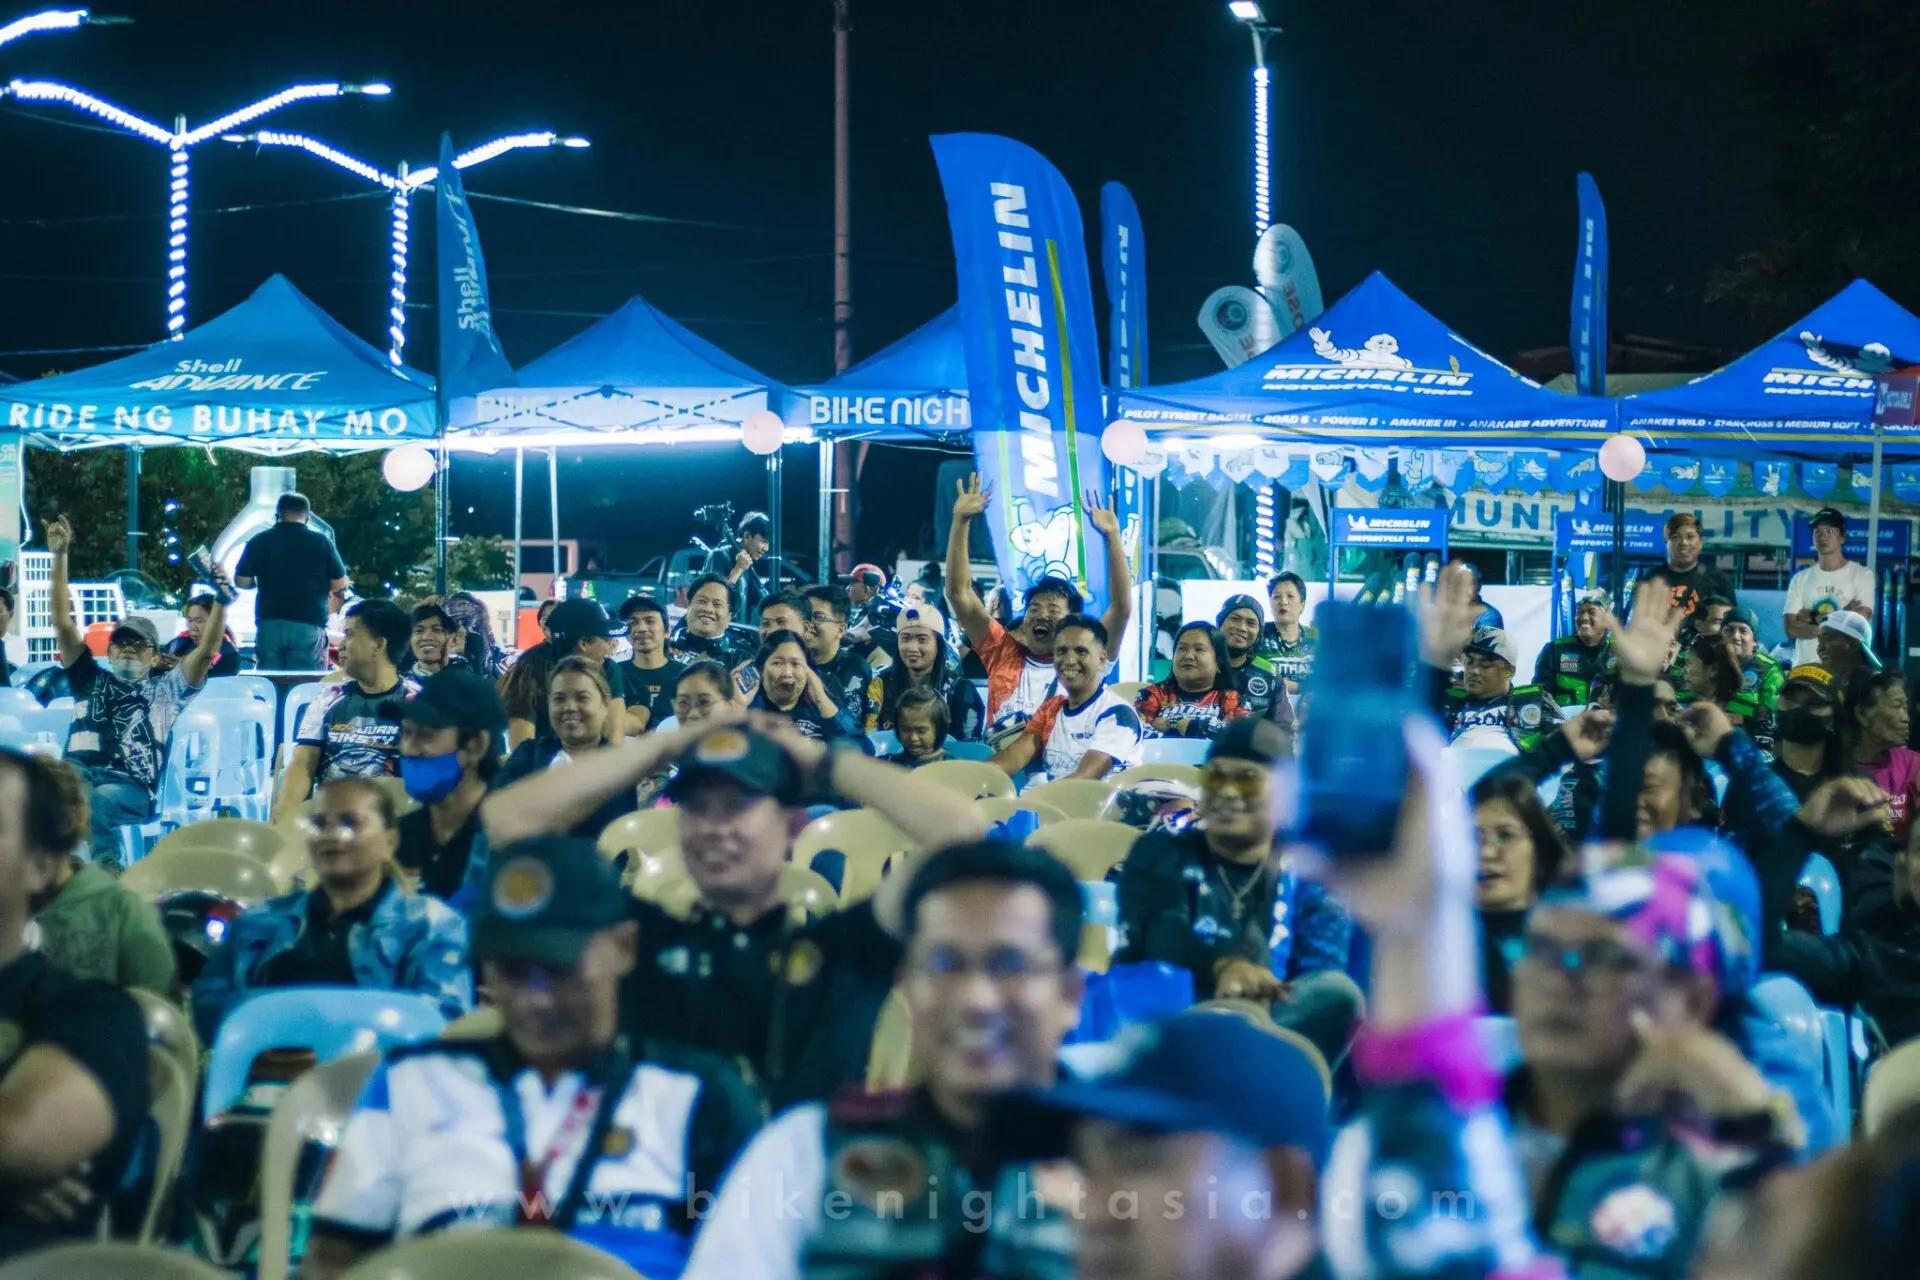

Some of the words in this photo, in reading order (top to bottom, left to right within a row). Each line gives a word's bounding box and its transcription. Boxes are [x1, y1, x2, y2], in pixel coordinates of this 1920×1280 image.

[453, 266, 474, 330] Shell
[990, 182, 1058, 496] MICHELIN
[175, 358, 242, 373] Shell
[129, 371, 328, 391] ADVANCE
[1263, 368, 1470, 387] MICHELIN
[1762, 372, 1875, 389] MICH
[1261, 383, 1409, 392] MOTORCYCLE
[1413, 387, 1473, 396] TIRES
[9, 403, 97, 430] RIDE
[114, 405, 172, 432] NG
[194, 405, 325, 435] BUHAY
[344, 407, 408, 436] MO
[810, 396, 885, 424] BIKE
[891, 397, 968, 425] NIGH
[1124, 410, 1160, 419] PILOT
[1161, 411, 1205, 421] STREET
[1207, 413, 1252, 422] RADIAL
[1263, 415, 1298, 424] ROAD
[1320, 416, 1367, 425] POWER
[1390, 418, 1441, 427] ANAKEE
[1531, 419, 1607, 428] ADVENTURE
[1630, 418, 1676, 426] ANAKEE
[1677, 418, 1706, 427] WILD
[1784, 420, 1830, 429] MEDIUM
[1832, 421, 1860, 430] SOFT
[1369, 519, 1430, 528] MICHELIN
[1347, 534, 1404, 542] MOTORCYCLE
